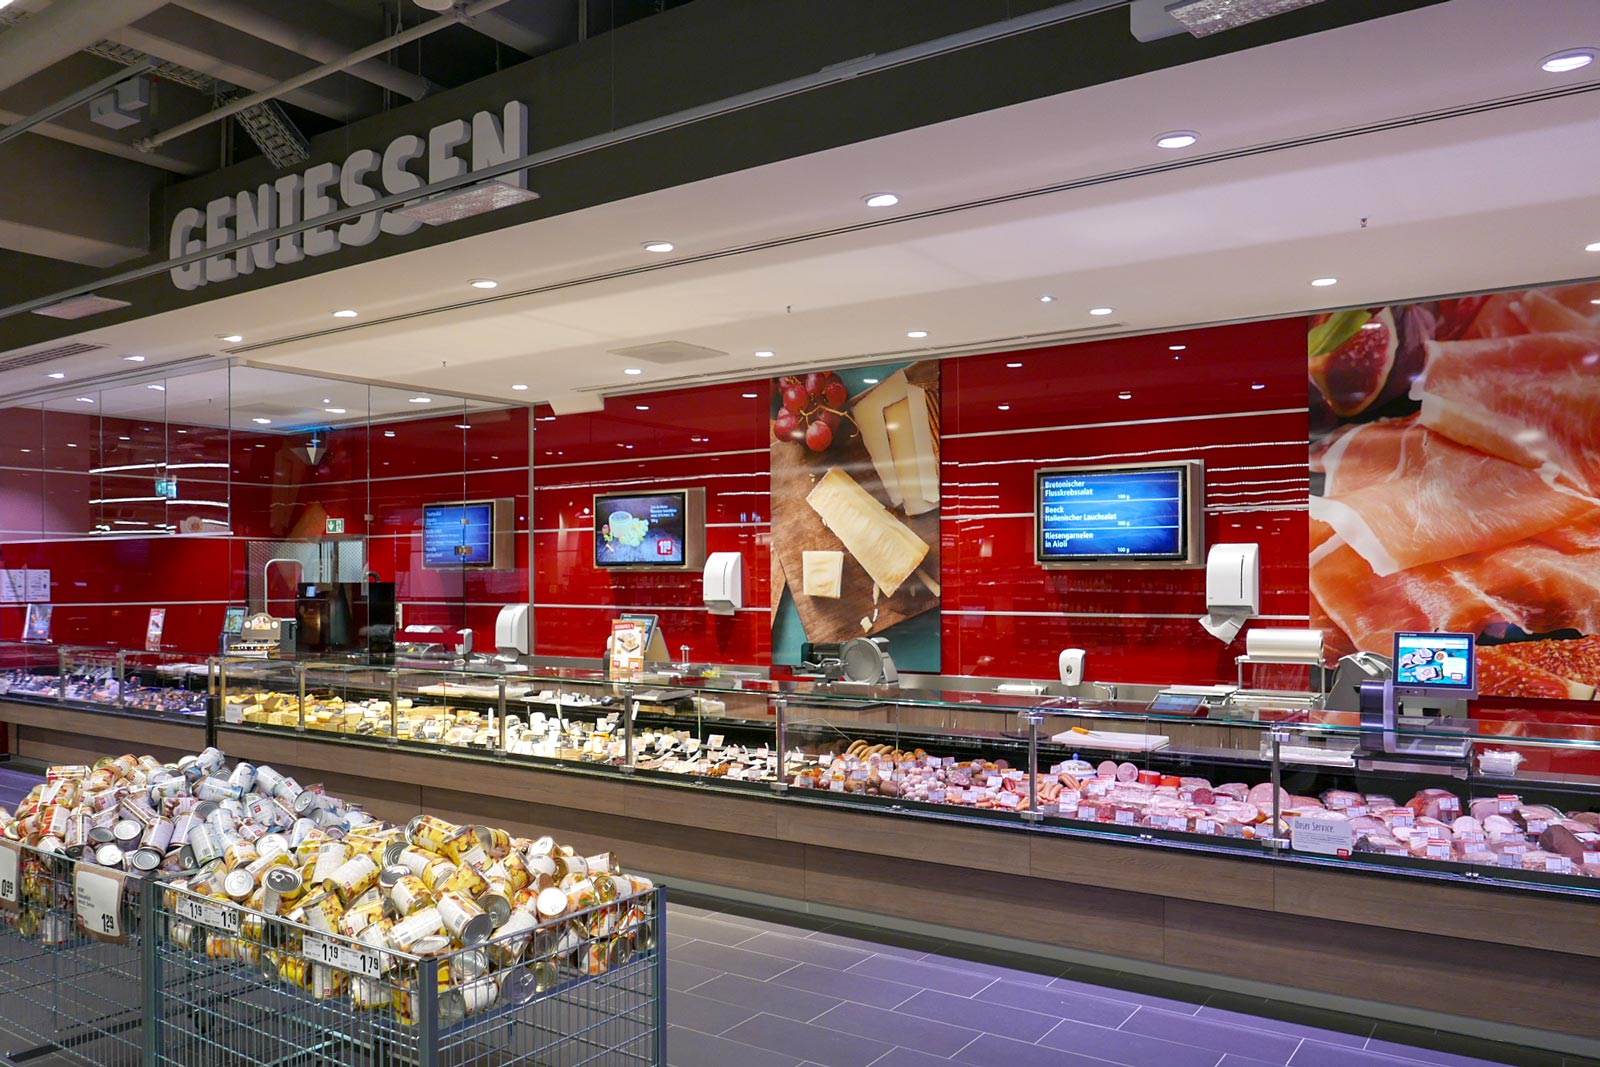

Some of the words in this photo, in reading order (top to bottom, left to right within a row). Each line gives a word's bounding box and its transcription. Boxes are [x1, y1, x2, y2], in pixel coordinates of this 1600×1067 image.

[169, 100, 529, 291] GENIESSEN
[1045, 480, 1085, 488] Bretonischer
[1045, 488, 1093, 497] Flusskrebssalat
[1083, 512, 1117, 521] Lauchsalat
[1045, 531, 1094, 541] Riesengarnelen
[1052, 540, 1068, 548] Aioli
[1294, 820, 1310, 830] Unser
